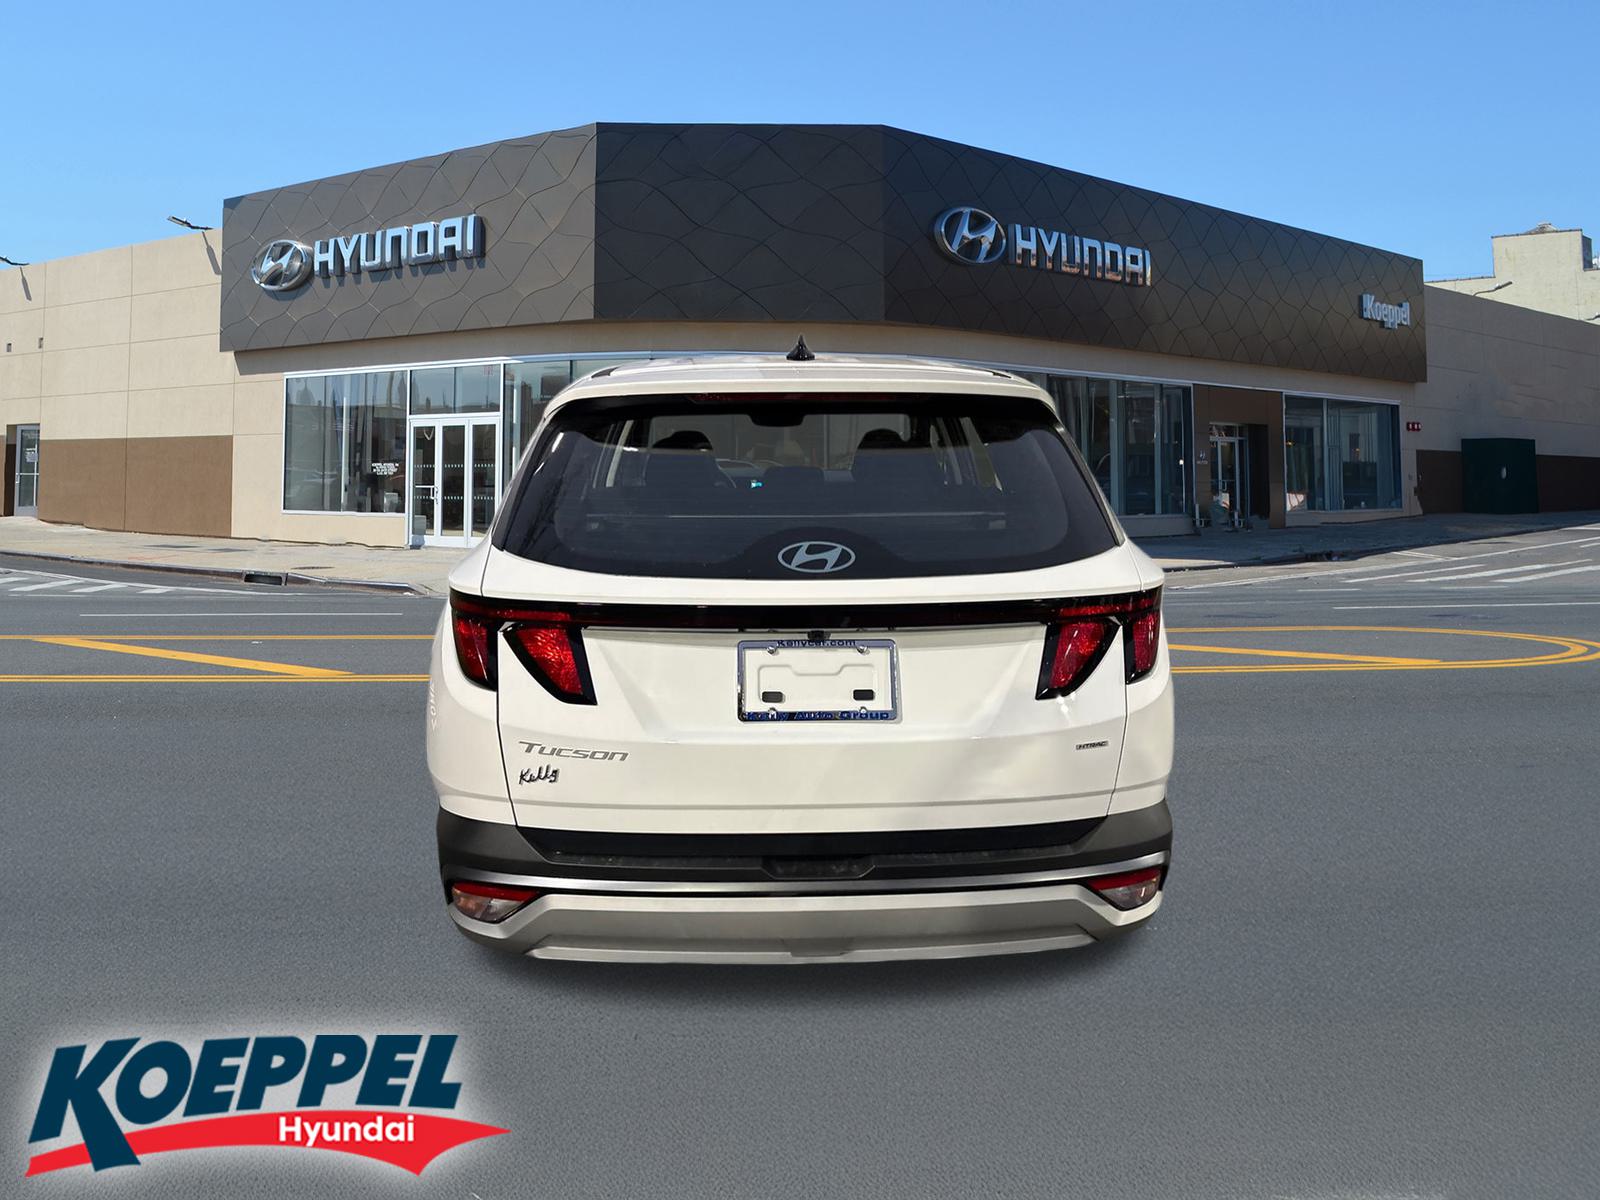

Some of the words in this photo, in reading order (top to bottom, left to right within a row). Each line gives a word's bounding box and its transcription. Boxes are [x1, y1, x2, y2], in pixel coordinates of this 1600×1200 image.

[313, 213, 484, 278] HYUNDAI
[1011, 223, 1151, 286] HYUNDAI
[1361, 293, 1410, 329] Koeppel
[839, 710, 890, 721] Group
[518, 763, 559, 785] Kelly
